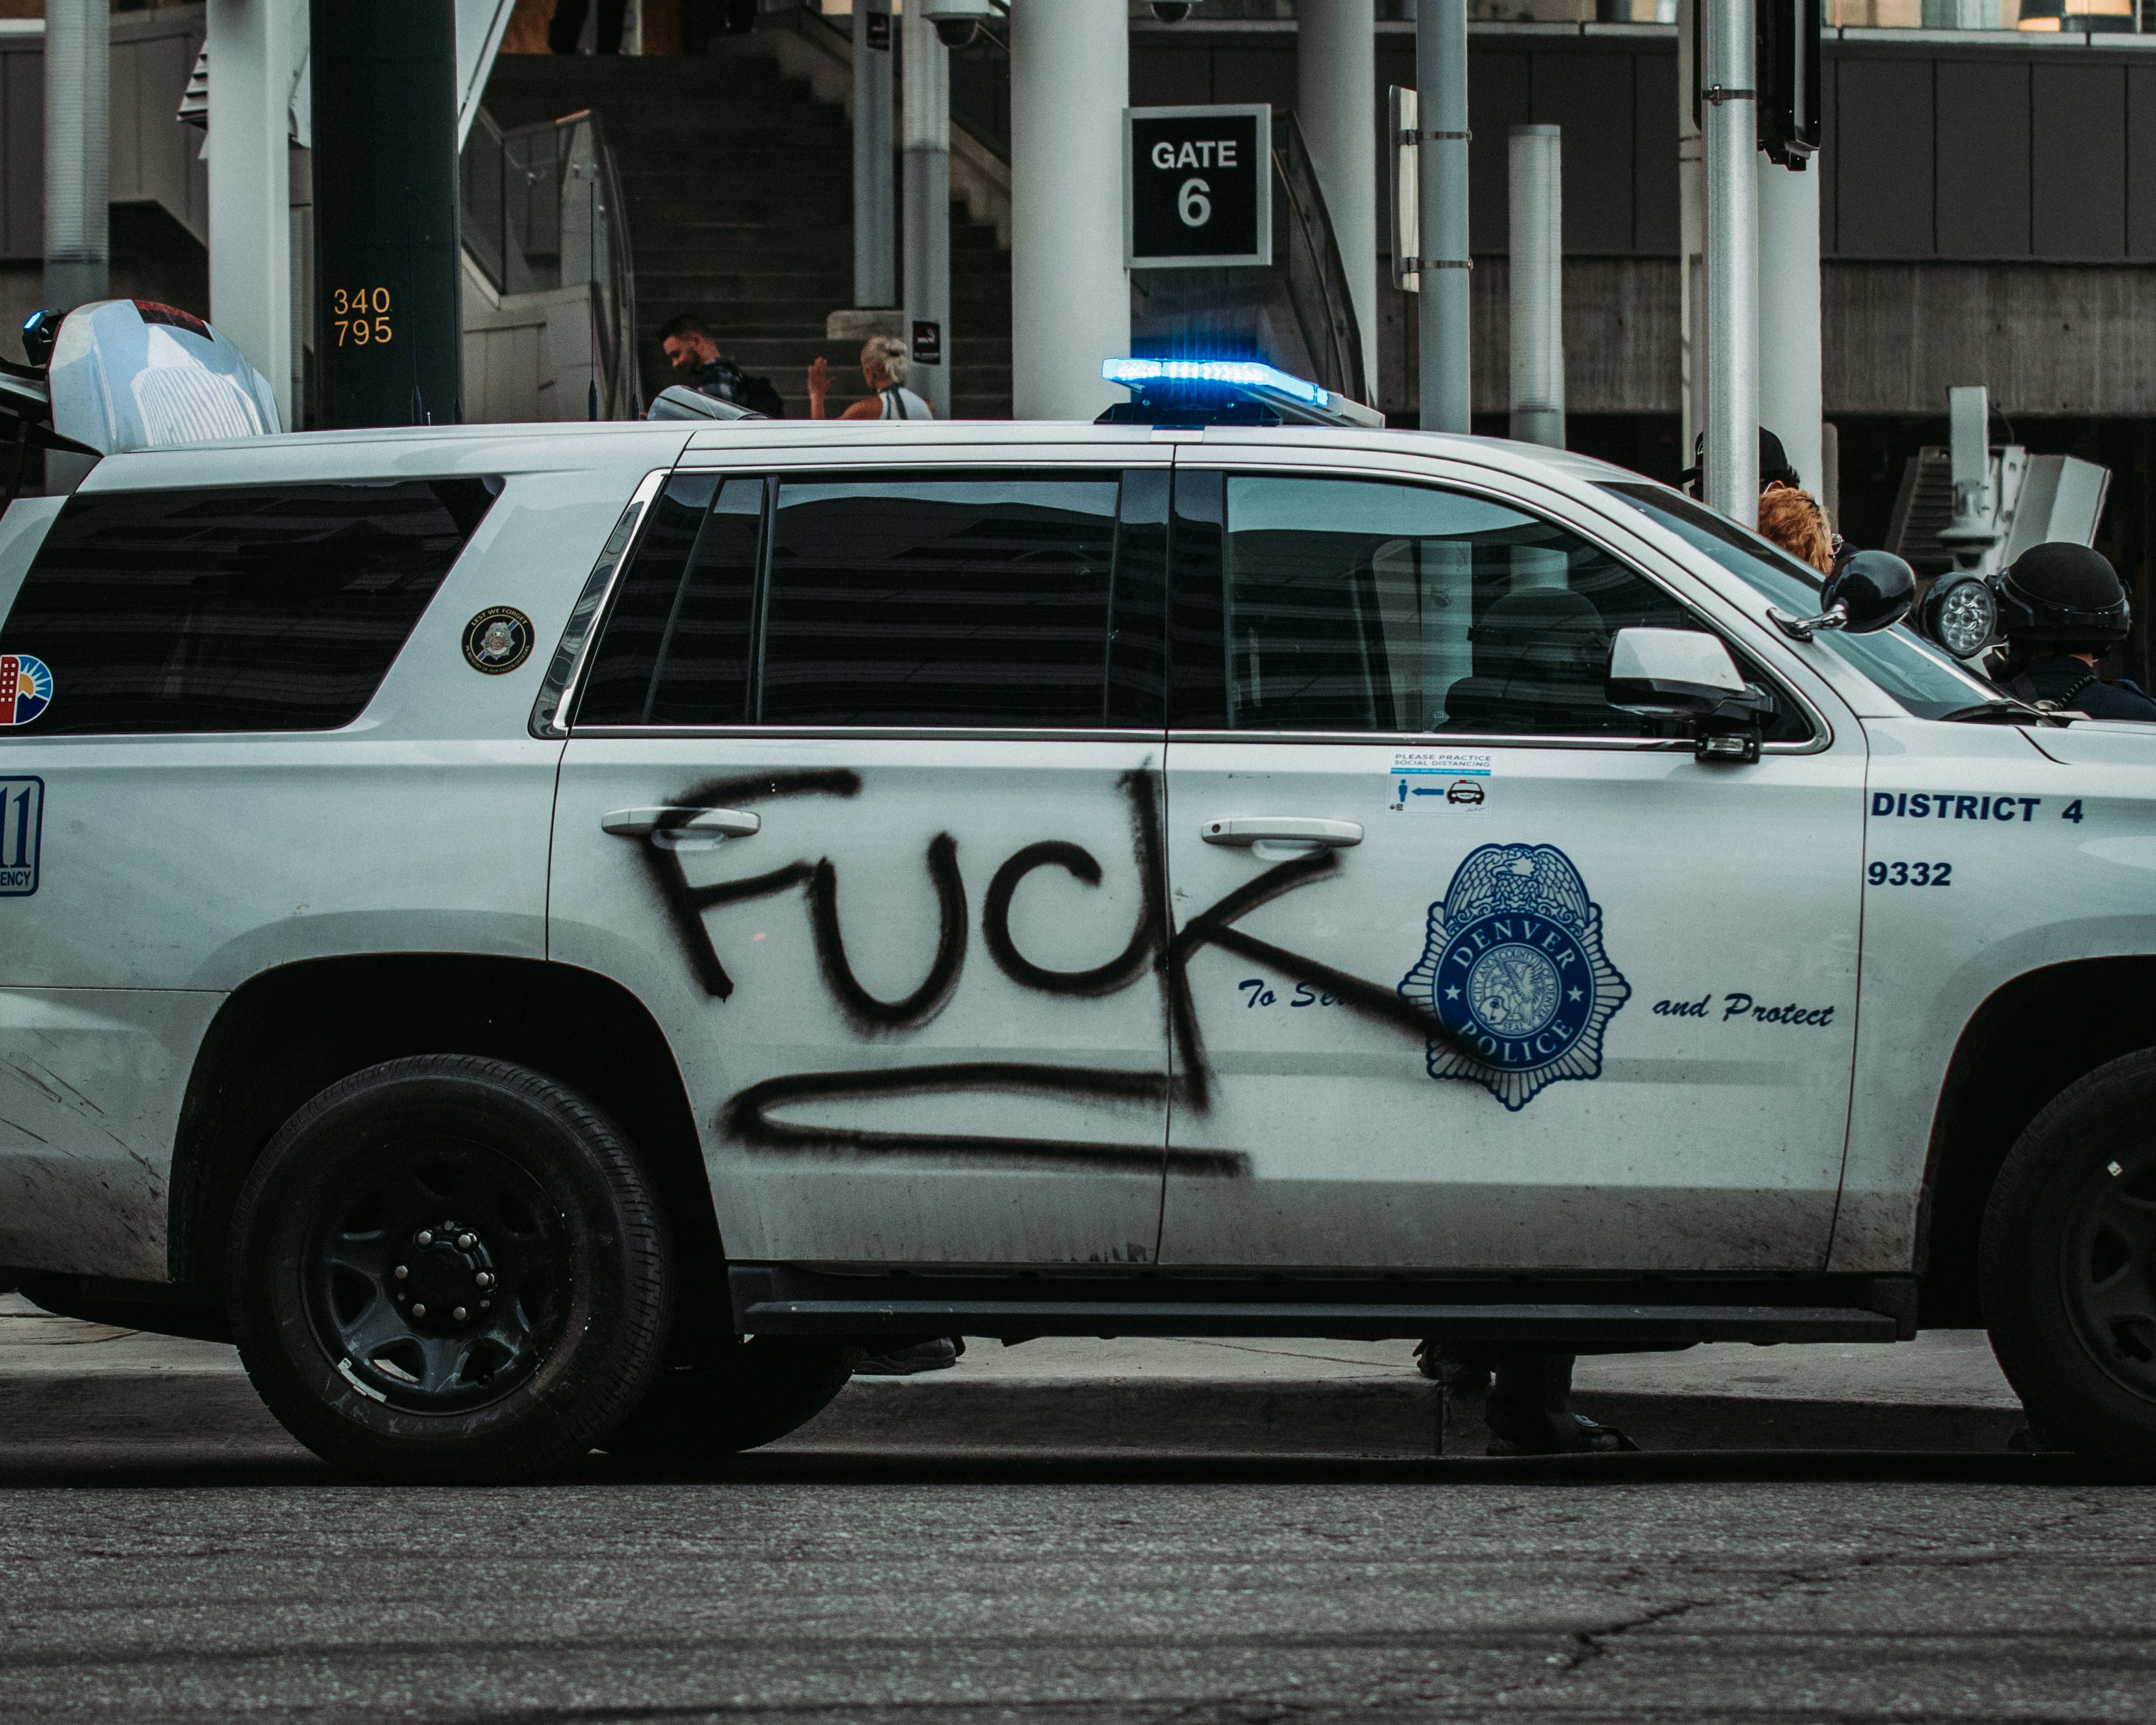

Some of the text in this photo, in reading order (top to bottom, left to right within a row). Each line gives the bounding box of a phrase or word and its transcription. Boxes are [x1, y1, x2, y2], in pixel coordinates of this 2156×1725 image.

[1152, 140, 1237, 169] GATE
[1179, 178, 1211, 227] 6
[334, 287, 390, 314] 340
[334, 317, 392, 346] 795
[471, 613, 486, 626] LEST
[502, 608, 528, 625] FORGET
[499, 663, 515, 672] FALLEN
[515, 645, 530, 666] OFFICERS
[1871, 792, 2084, 823] DISTRICT 4
[1868, 861, 1953, 886] 9332
[637, 761, 1471, 1112] FUCK
[1452, 919, 1576, 970] DENVER
[1473, 980, 1483, 1002] CITY
[1479, 957, 1494, 977] AND
[1499, 949, 1541, 966] COUNTY
[1238, 979, 1276, 1008] To
[1651, 994, 1712, 1017] and
[1722, 992, 1835, 1026] Protect
[1457, 1019, 1573, 1062] POLICE
